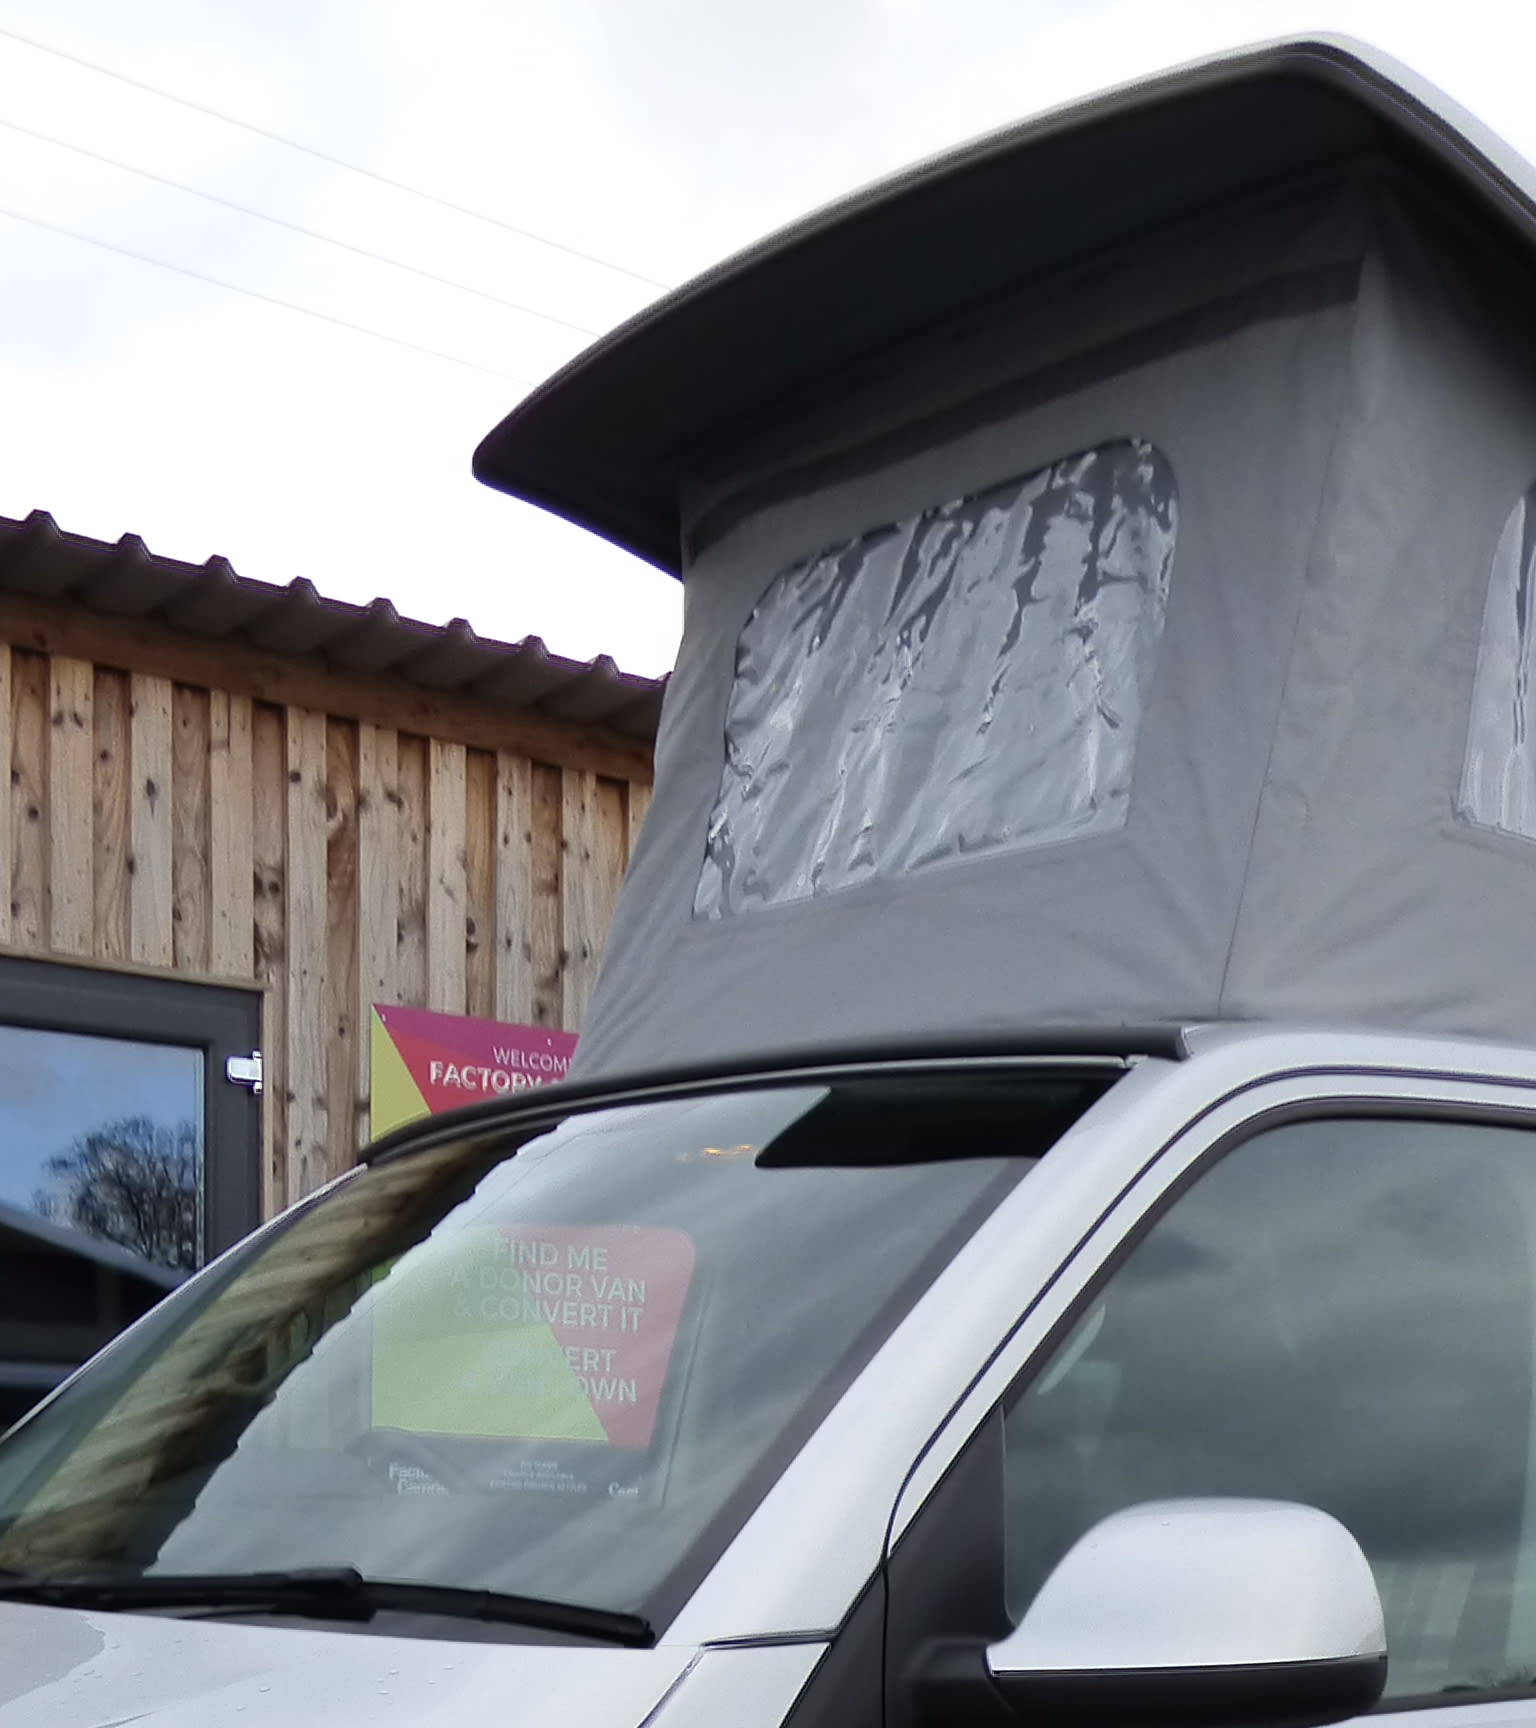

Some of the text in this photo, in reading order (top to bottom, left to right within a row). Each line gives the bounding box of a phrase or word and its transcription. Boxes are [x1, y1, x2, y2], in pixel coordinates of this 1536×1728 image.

[492, 1046, 572, 1073] WELCOM
[495, 1238, 609, 1272] FIND ME
[479, 1266, 583, 1298] DONOR
[591, 1276, 645, 1303] VAN
[480, 1296, 612, 1328] CONVERT
[620, 1306, 644, 1332] IT
